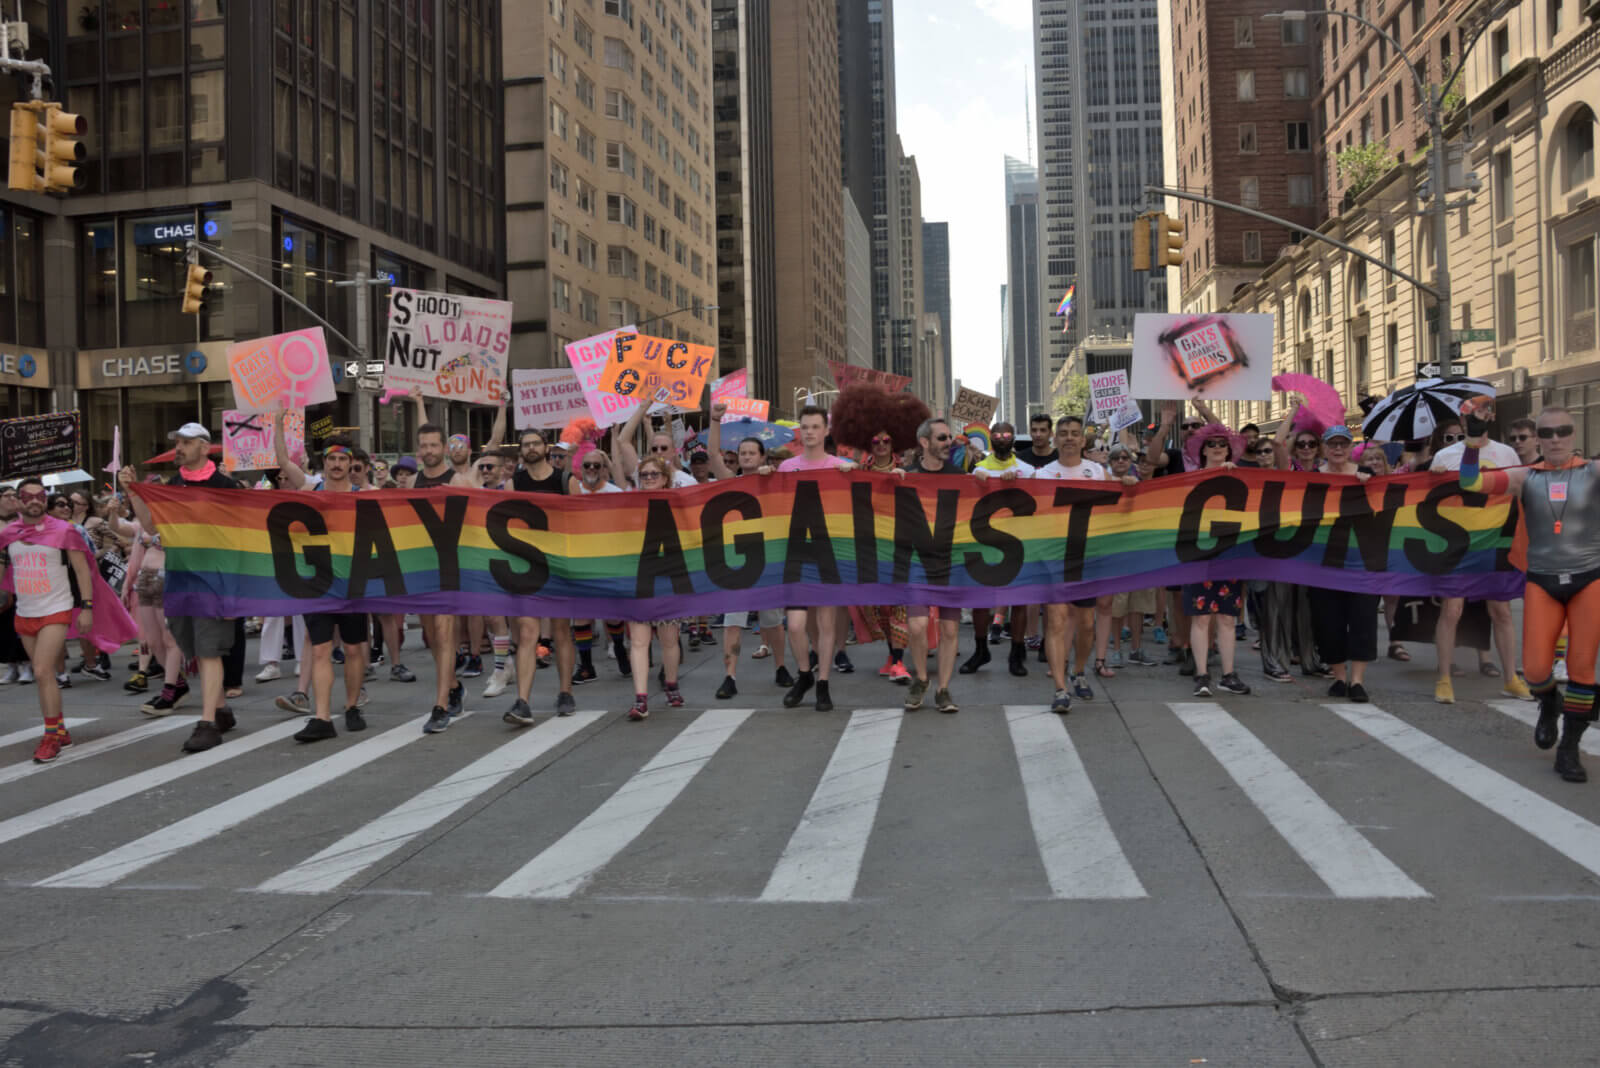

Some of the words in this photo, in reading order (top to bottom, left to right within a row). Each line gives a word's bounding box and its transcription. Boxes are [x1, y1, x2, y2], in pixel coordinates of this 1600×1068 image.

[154, 224, 195, 239] CHAS
[393, 290, 461, 325] SHOOT
[425, 320, 509, 354] LOADS
[1181, 327, 1217, 352] GAYS
[388, 331, 443, 371] NOT
[615, 334, 711, 378] FUCK
[1190, 350, 1228, 375] GUNS
[102, 354, 182, 377] CHASE
[435, 367, 500, 401] GUNS
[520, 388, 538, 401] MY
[541, 382, 582, 397] FAGGO
[614, 368, 688, 402] GUNS
[1092, 373, 1127, 389] MORE
[520, 401, 564, 417] WHITE
[266, 494, 551, 600] GAYS
[635, 479, 1123, 599] AGAINST
[15, 552, 48, 568] GAYS
[17, 578, 51, 595] GUNS
